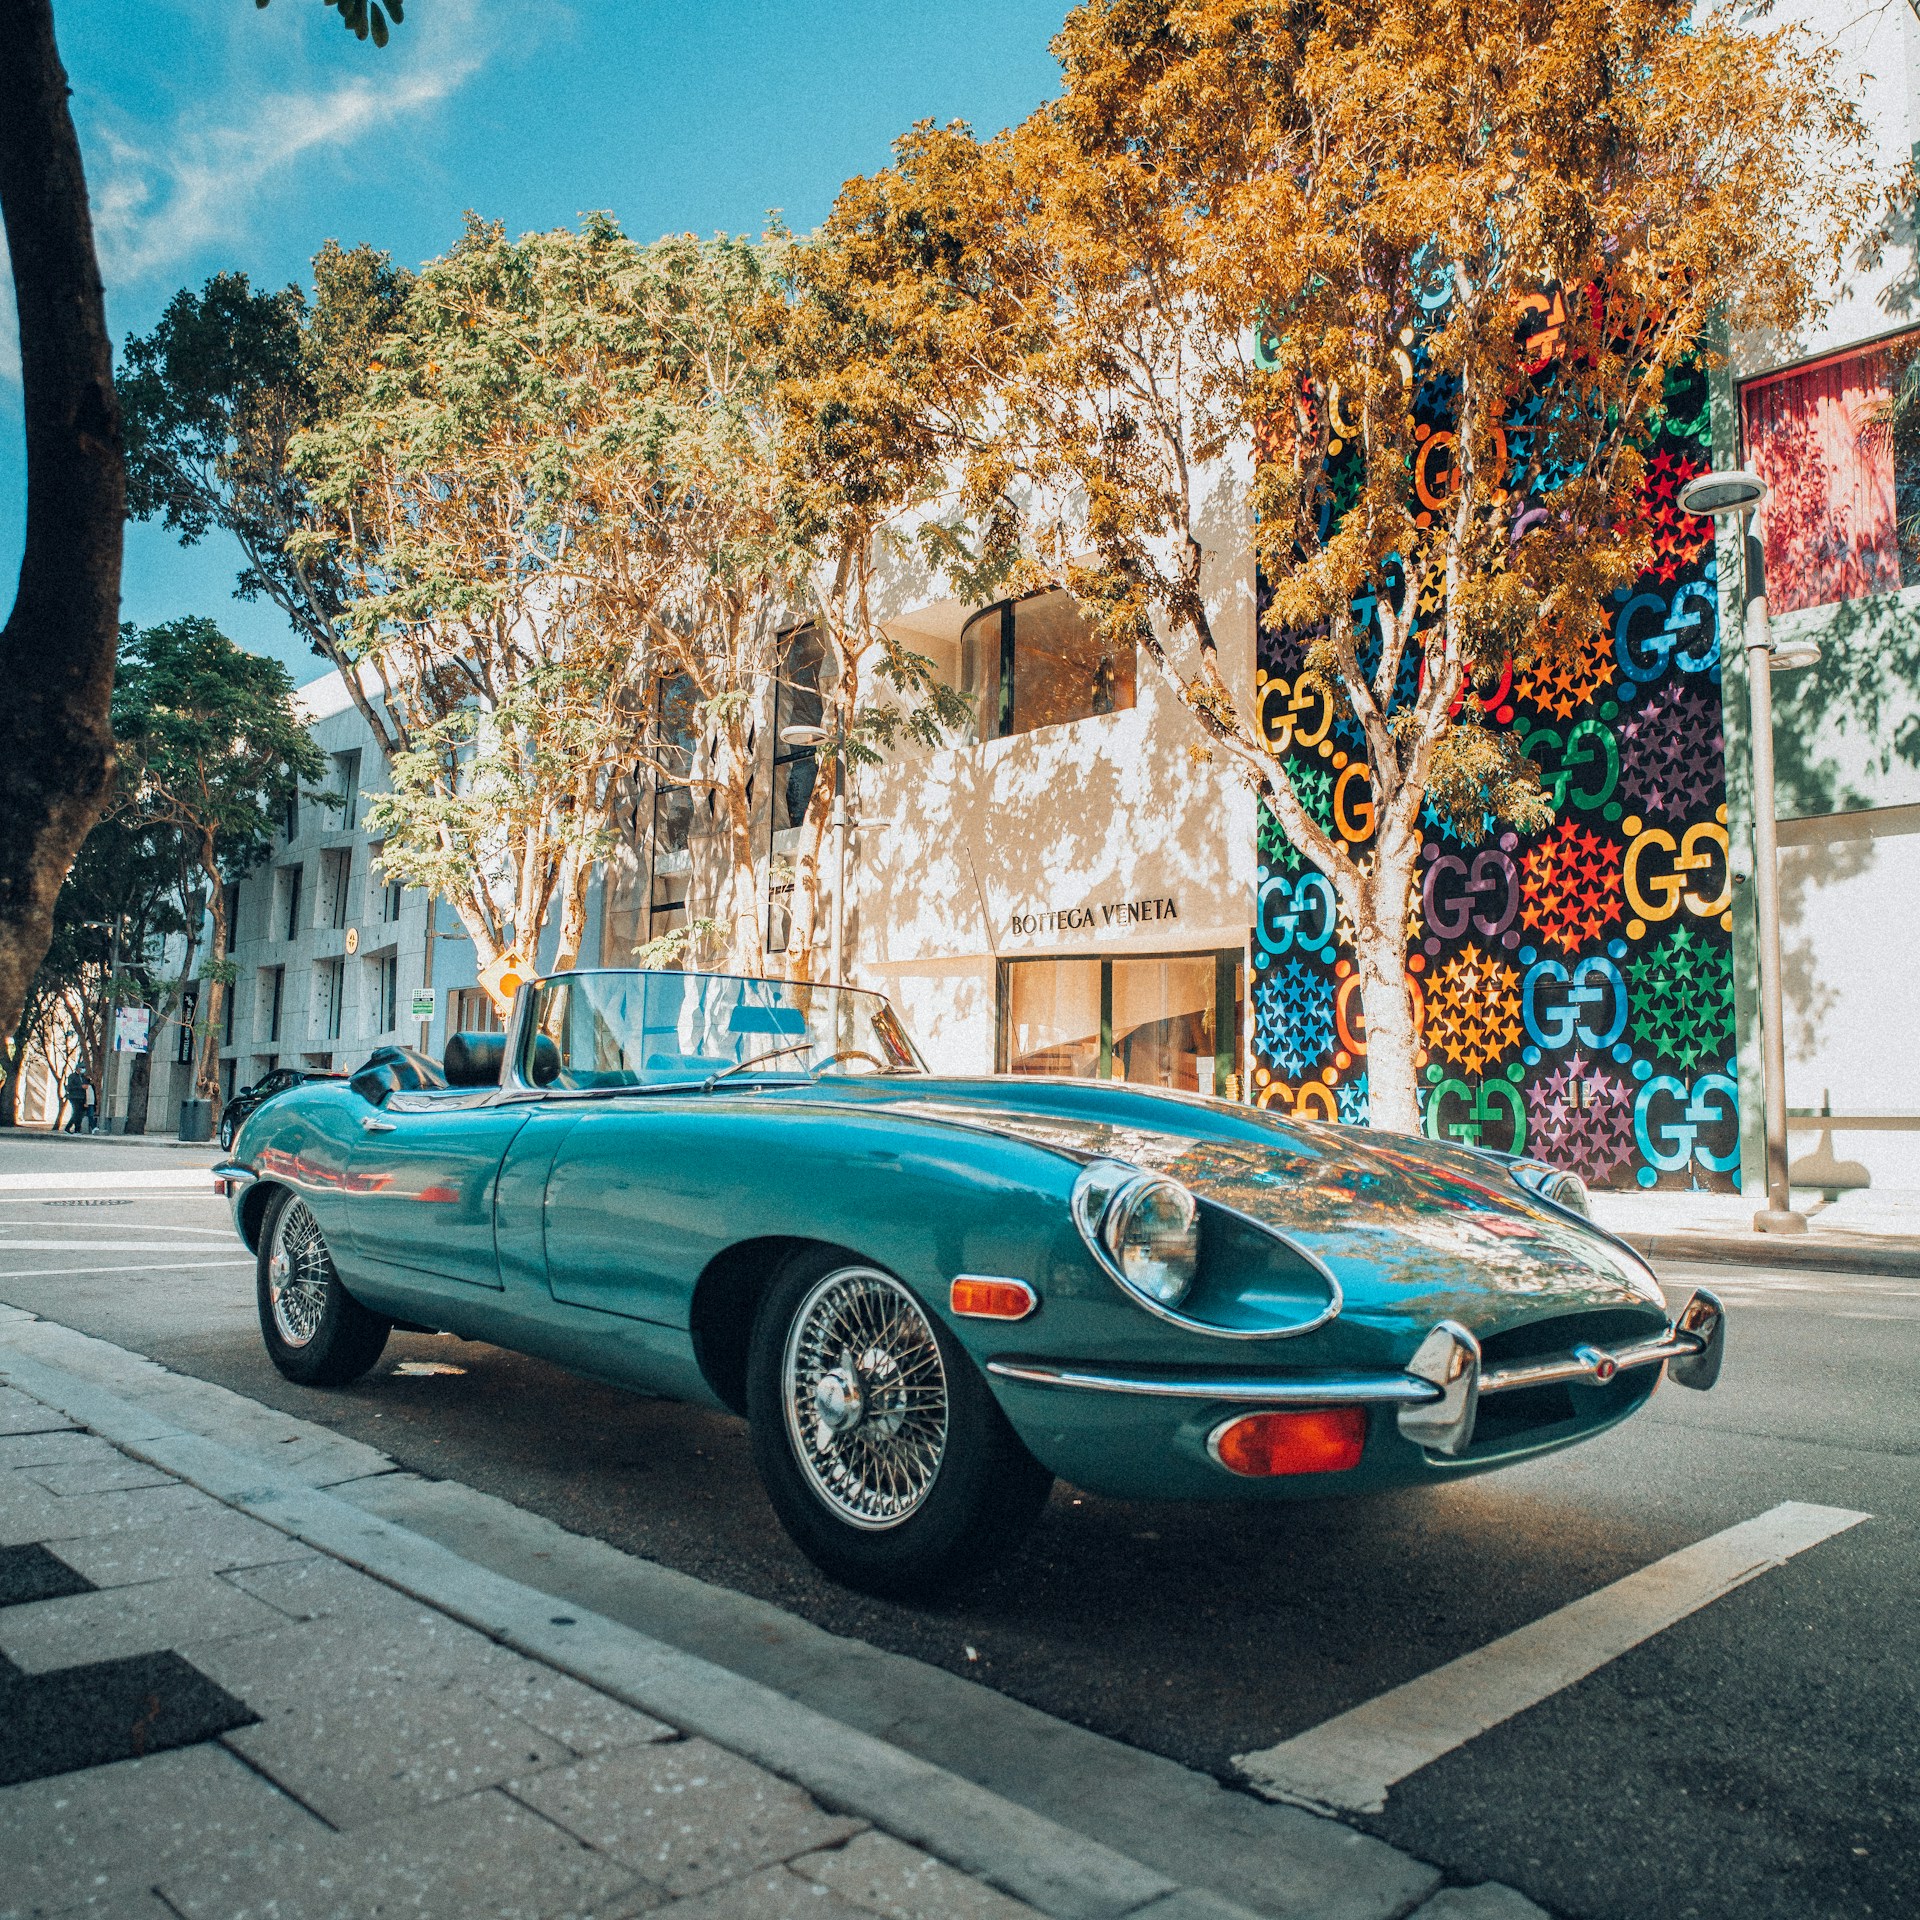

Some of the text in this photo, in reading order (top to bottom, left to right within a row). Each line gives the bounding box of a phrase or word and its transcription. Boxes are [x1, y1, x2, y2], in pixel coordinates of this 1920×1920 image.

[1617, 581, 1720, 682] GG
[1012, 898, 1178, 935] BOTTEGA VENETA
[1257, 871, 1336, 955] GG
[1423, 853, 1519, 939] GG
[1623, 822, 1731, 922] GG
[1522, 956, 1628, 1049] GG
[1634, 1074, 1741, 1172] GG
